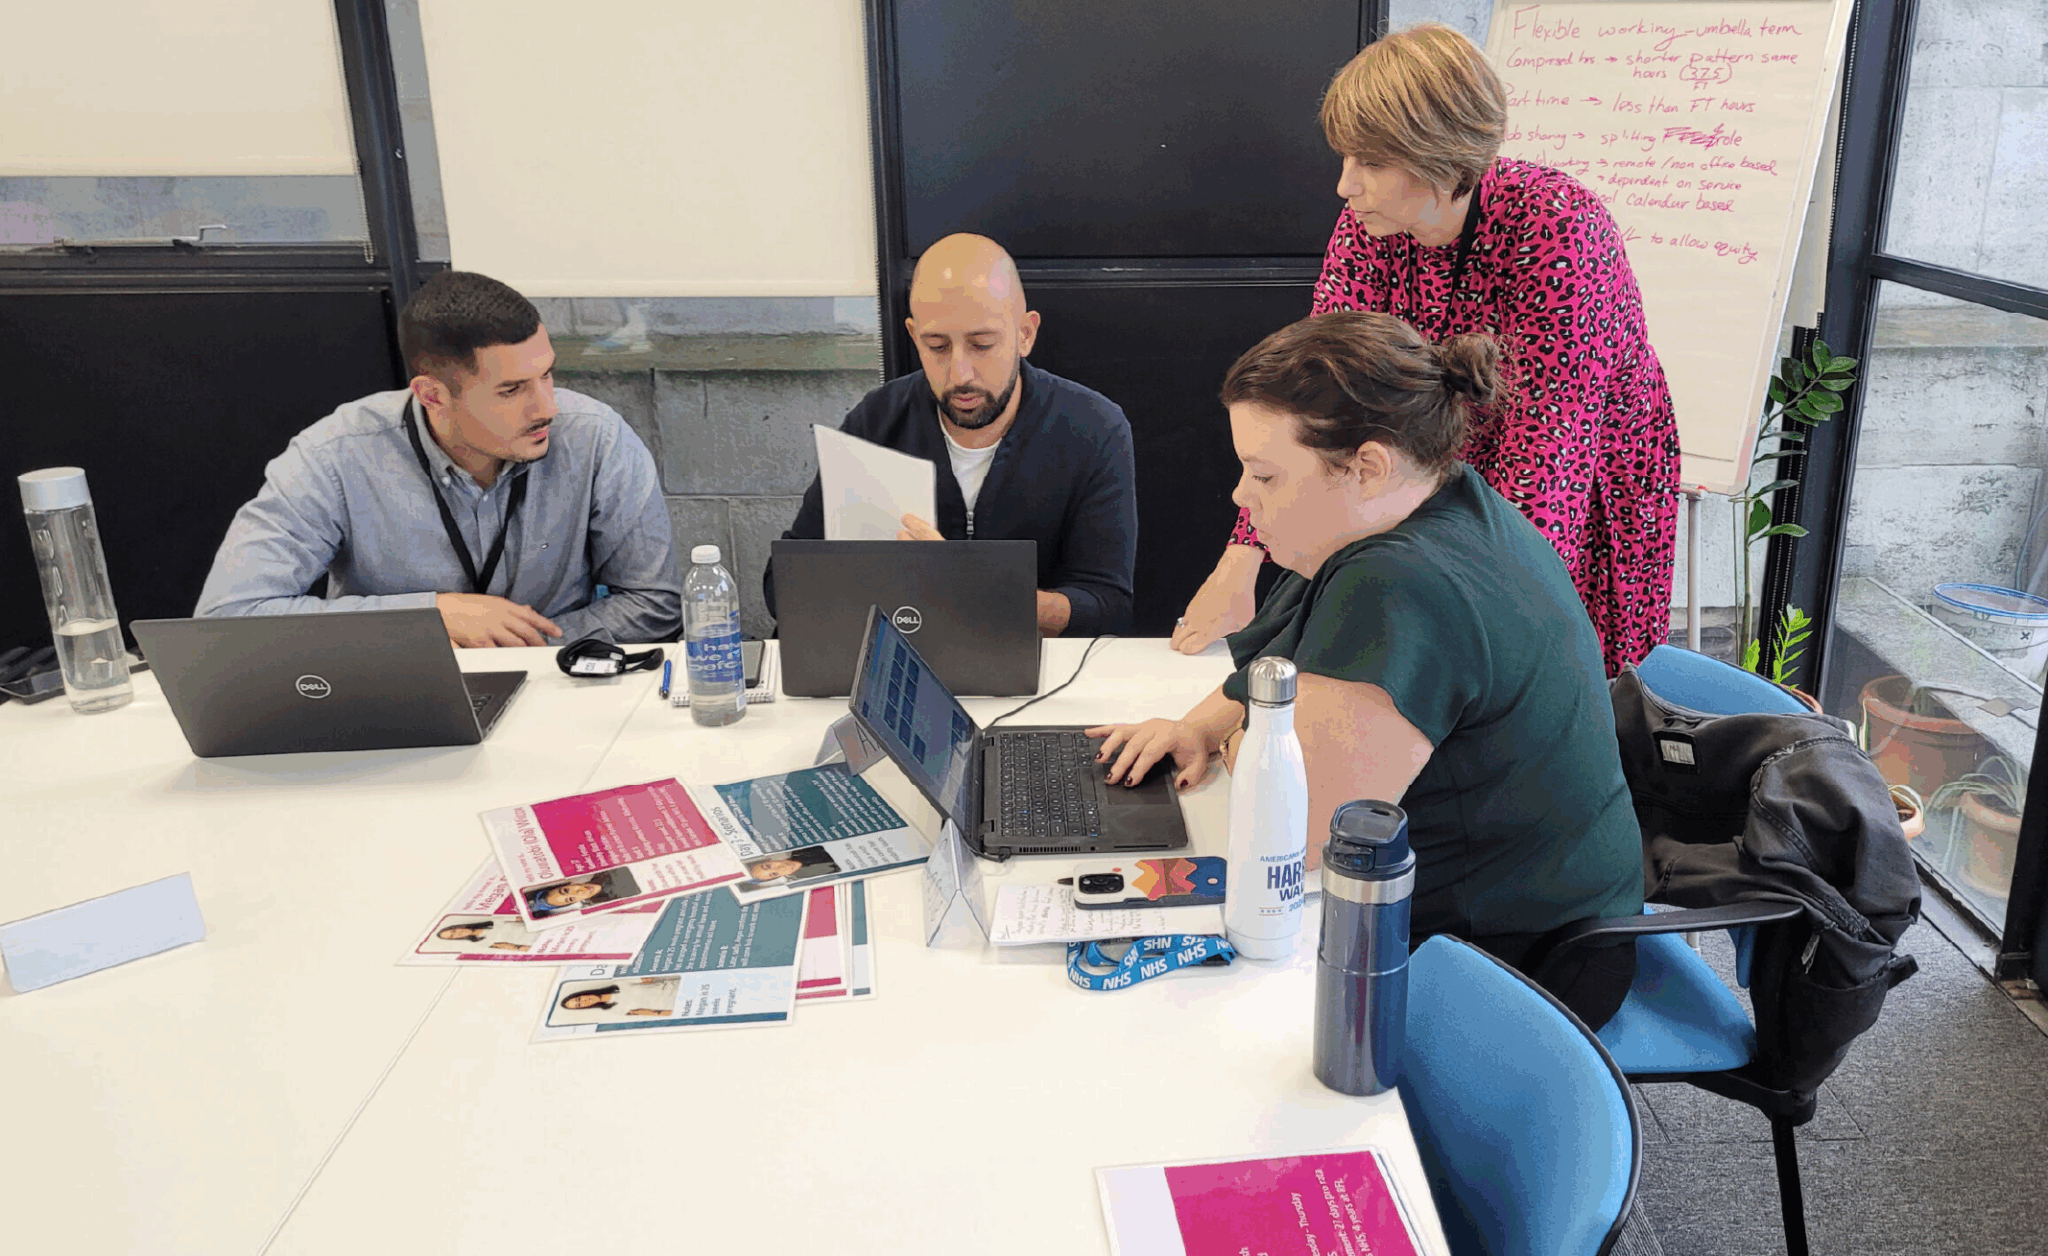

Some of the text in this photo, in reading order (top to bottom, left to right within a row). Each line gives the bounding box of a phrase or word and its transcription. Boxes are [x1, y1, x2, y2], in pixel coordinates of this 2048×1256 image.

[1513, 4, 1580, 41] Flexible
[1598, 18, 1688, 51] working
[1760, 17, 1802, 37] term
[1689, 48, 1753, 69] pattern
[1761, 53, 1799, 65] same
[1633, 66, 1667, 79] hours
[1535, 89, 1570, 106] time
[1612, 92, 1642, 113] less
[1649, 95, 1679, 114] than
[1690, 97, 1716, 113] FT
[1720, 98, 1756, 113] hours
[1612, 156, 1656, 169] remote
[1676, 180, 1692, 189] on
[1697, 179, 1742, 191] service
[1650, 232, 1664, 244] to
[1670, 234, 1708, 249] allow
[1177, 943, 1207, 966] NHS
[1069, 967, 1091, 988] NHS
[1140, 959, 1168, 979] NHS
[1103, 972, 1132, 990] NHS
[1291, 1192, 1308, 1226] Thursday
[1327, 1199, 1339, 1218] days
[1345, 1203, 1360, 1223] years
